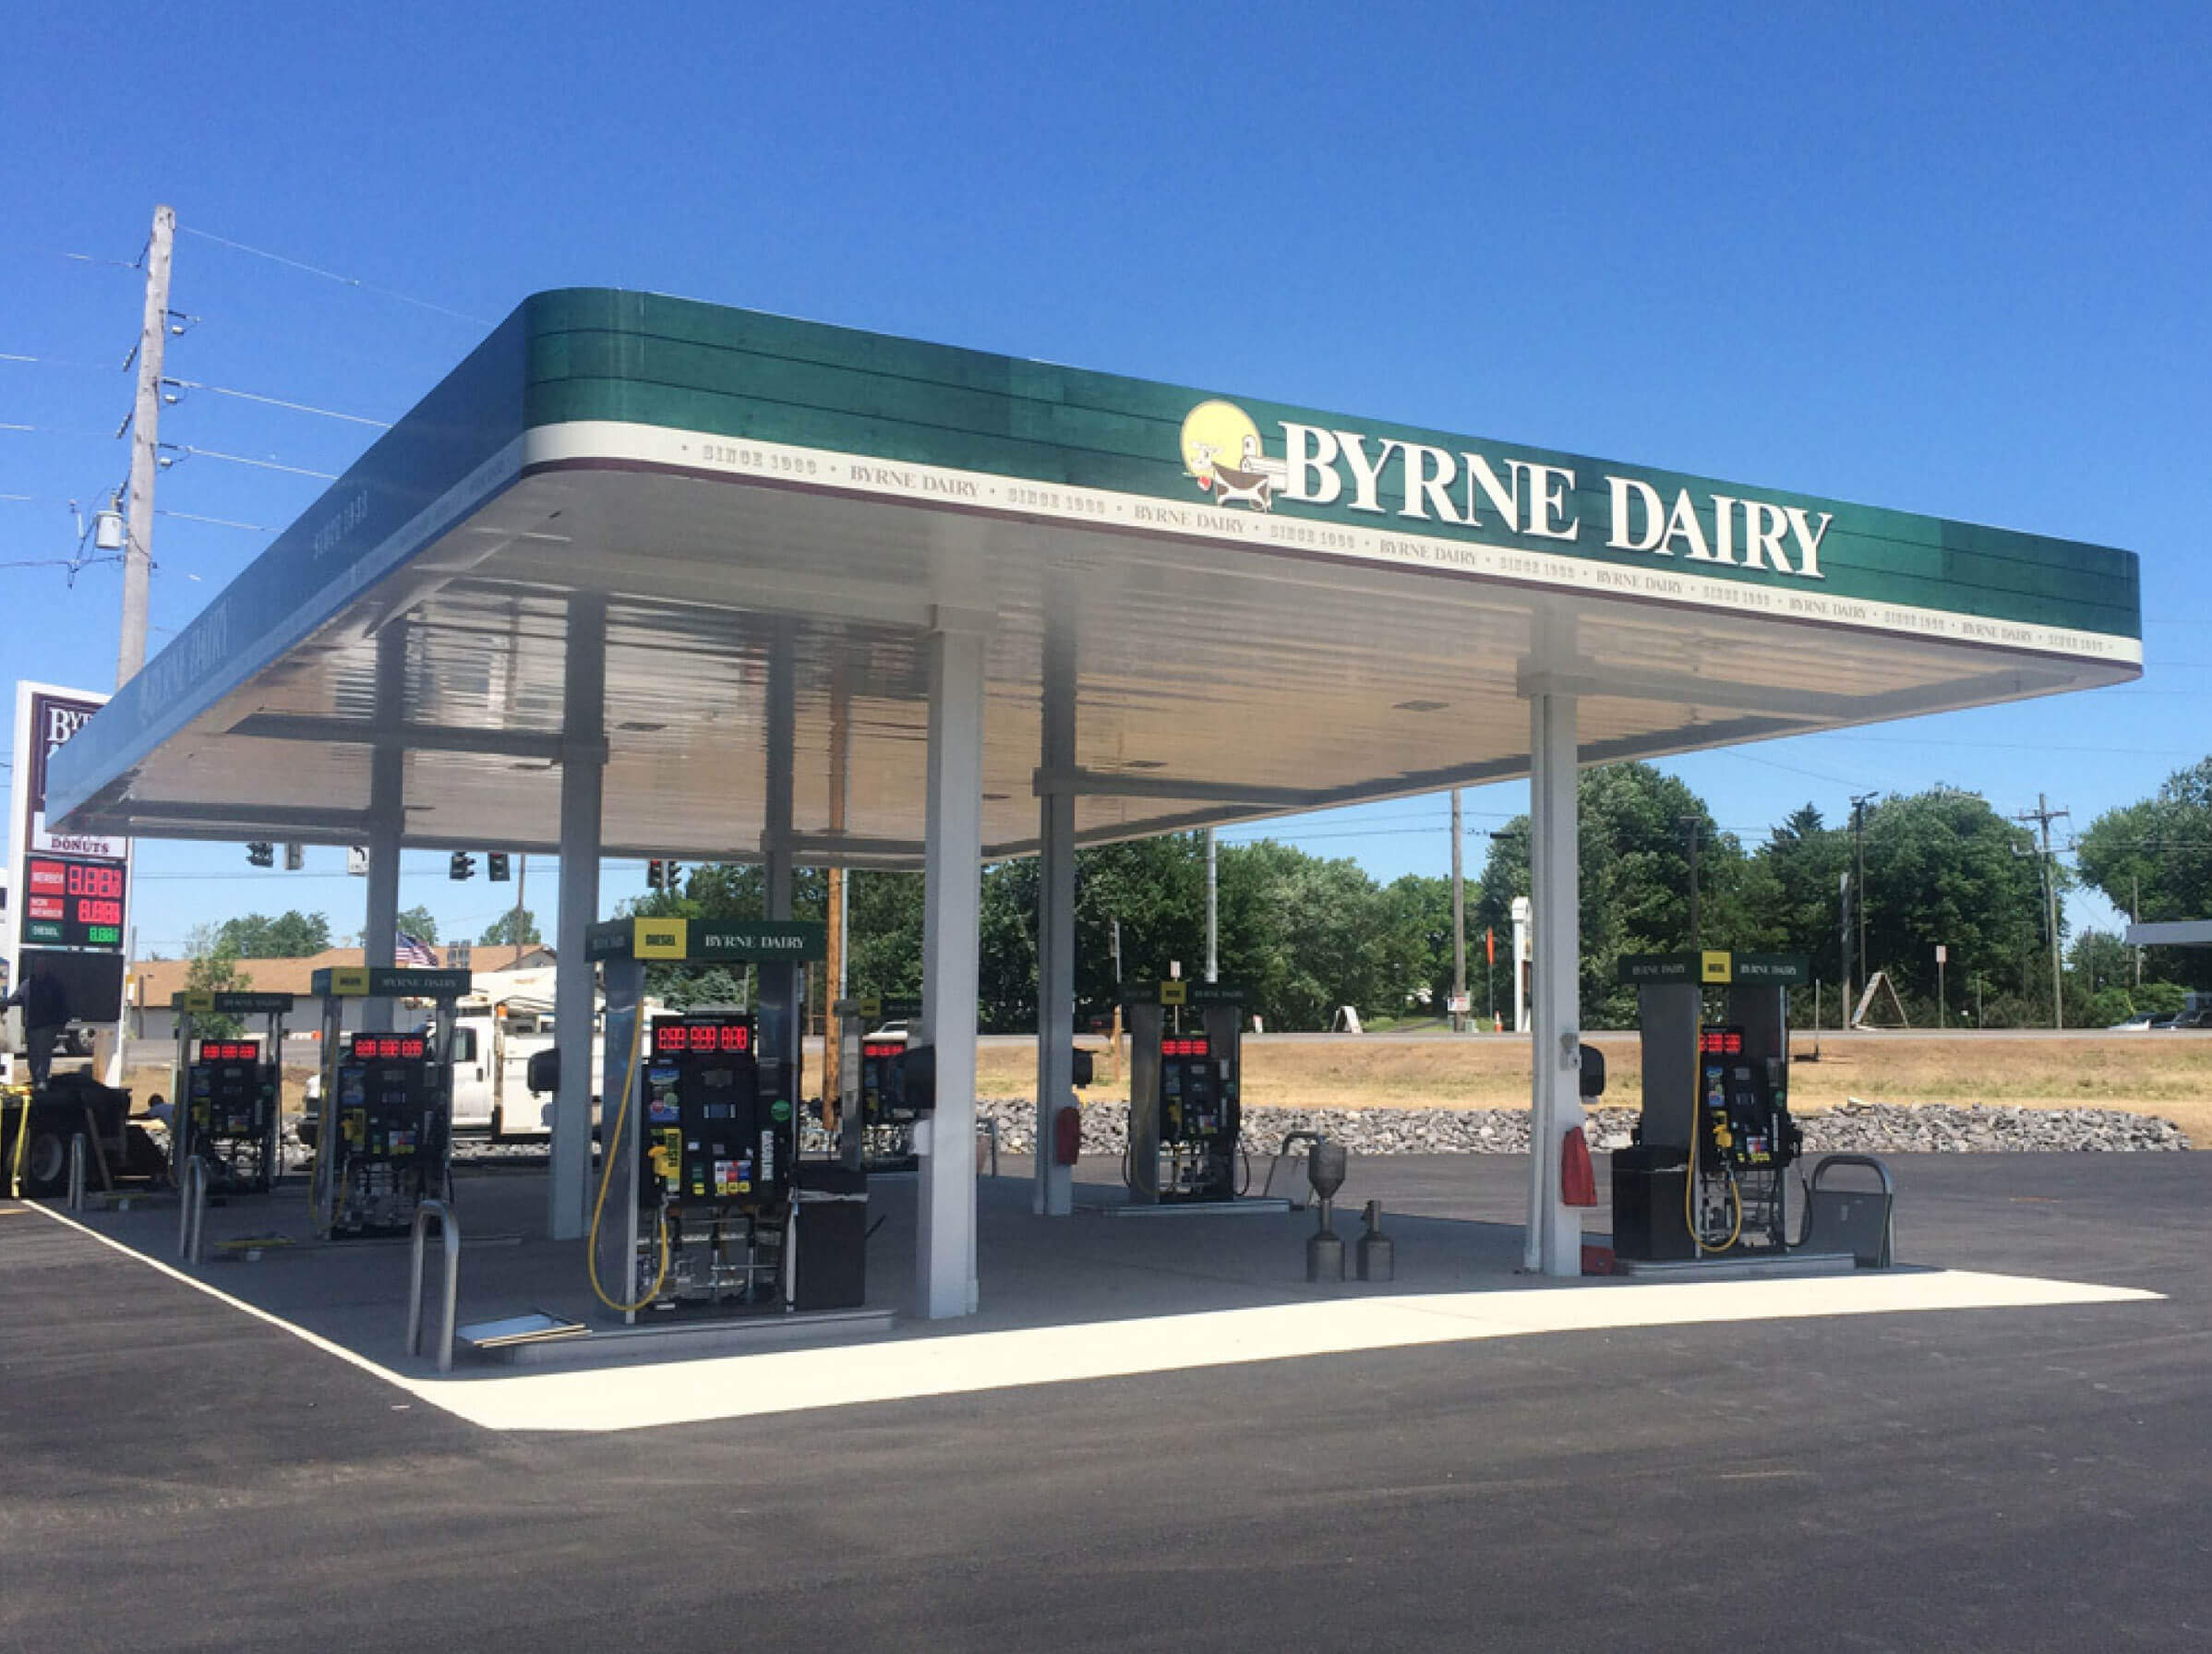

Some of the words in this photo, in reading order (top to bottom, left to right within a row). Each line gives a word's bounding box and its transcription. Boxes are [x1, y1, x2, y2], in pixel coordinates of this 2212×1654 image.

[1278, 420, 1578, 541] BYRNE
[1605, 474, 1833, 579] DAIRY
[850, 465, 917, 489] BYRNE
[923, 474, 980, 497] DAIRY
[1135, 504, 1194, 526] BYRNE
[1197, 513, 1244, 534] DAIRY
[1380, 539, 1430, 559] BYRNE
[1436, 545, 1477, 566] DAIRY
[1596, 569, 1641, 589] BYRNE
[1645, 577, 1684, 594] DAIRY
[1833, 603, 1867, 620] DAIRY
[51, 838, 110, 853] DONUTS
[705, 934, 754, 948] BYRNE
[761, 935, 804, 949] DAIRY
